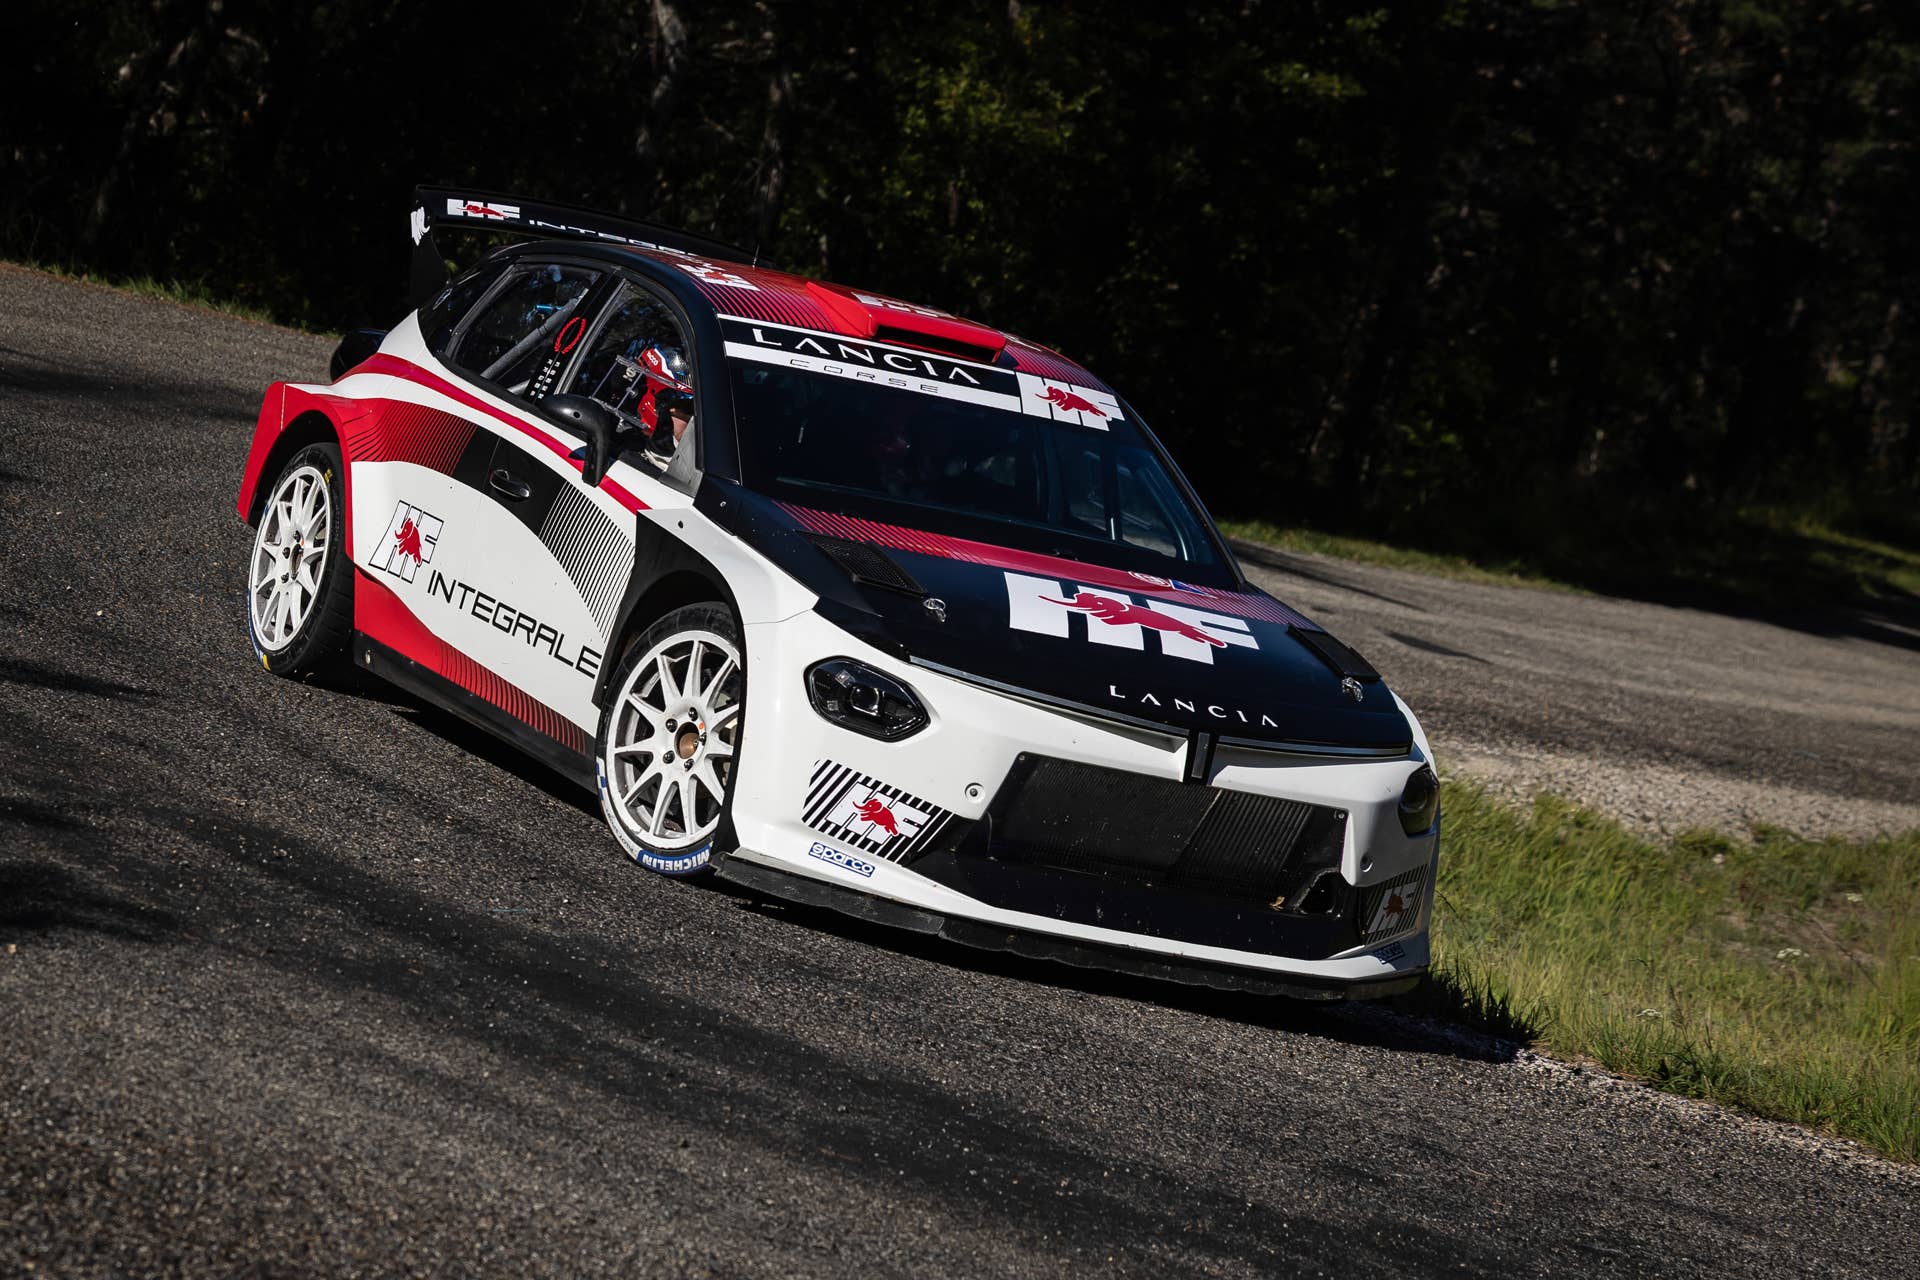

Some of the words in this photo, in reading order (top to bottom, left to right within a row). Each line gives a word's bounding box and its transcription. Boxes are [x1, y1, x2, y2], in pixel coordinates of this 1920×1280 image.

[447, 198, 521, 221] HF
[752, 328, 980, 385] LANCIA
[789, 359, 939, 393] CORSE
[1015, 371, 1126, 432] HF
[368, 500, 444, 584] HF
[427, 570, 602, 679] INTEGRALE
[1003, 571, 1260, 665] HF
[1109, 684, 1279, 728] LANCIA
[825, 781, 931, 845] HF
[642, 848, 710, 871] MICHELIN
[809, 841, 875, 877] sparco
